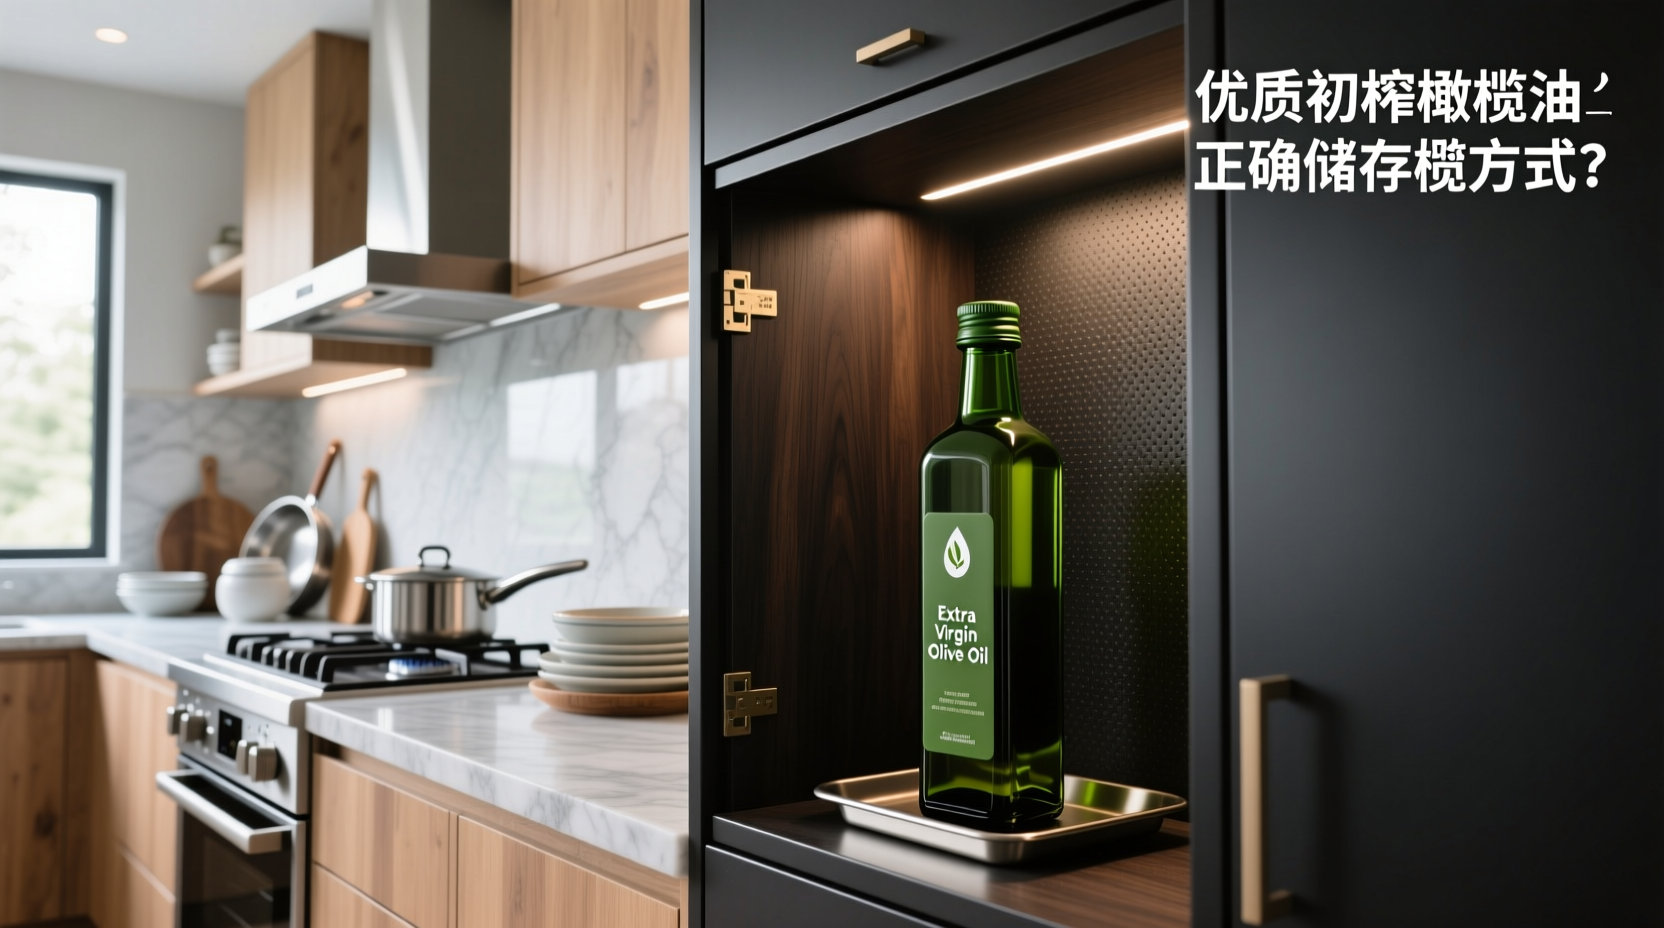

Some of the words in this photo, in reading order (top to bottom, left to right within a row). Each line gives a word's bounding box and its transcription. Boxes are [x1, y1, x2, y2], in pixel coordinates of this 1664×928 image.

[938, 605, 976, 623] Extra
[934, 623, 978, 646] Virgin
[928, 643, 964, 662] Olive
[967, 646, 988, 665] Oil
